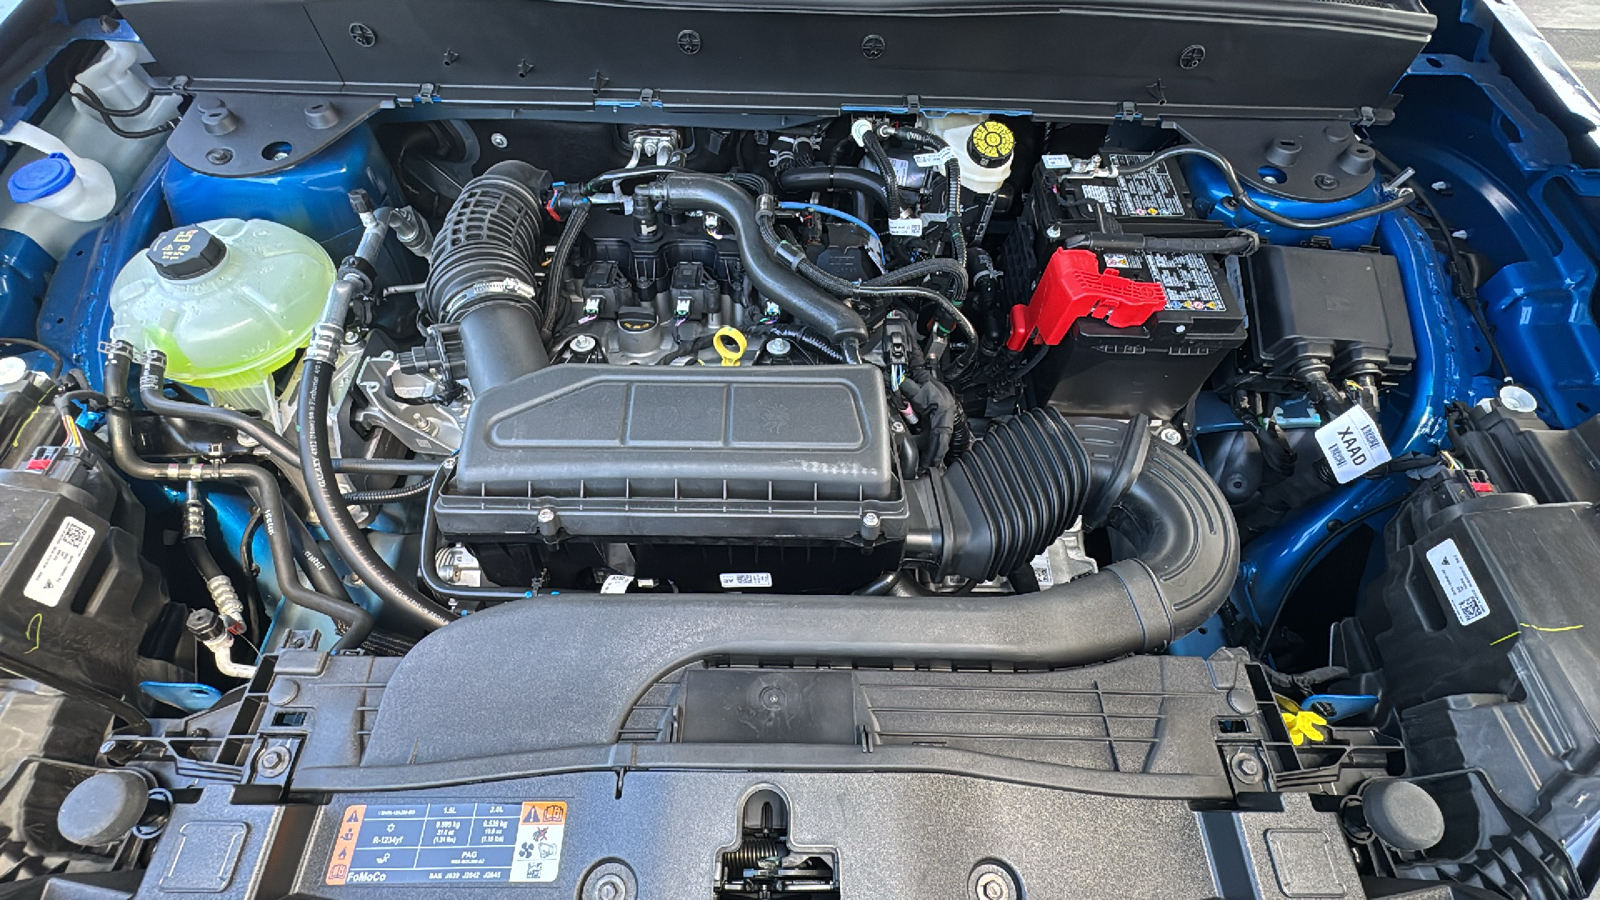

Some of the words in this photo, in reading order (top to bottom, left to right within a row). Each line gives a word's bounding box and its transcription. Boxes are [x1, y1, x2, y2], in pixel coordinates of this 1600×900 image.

[1337, 425, 1368, 466] XAAD
[443, 806, 457, 814] 1.5L
[372, 835, 404, 846] R-1234yf
[461, 850, 478, 859] PAG
[346, 871, 387, 883] FoMoCo
